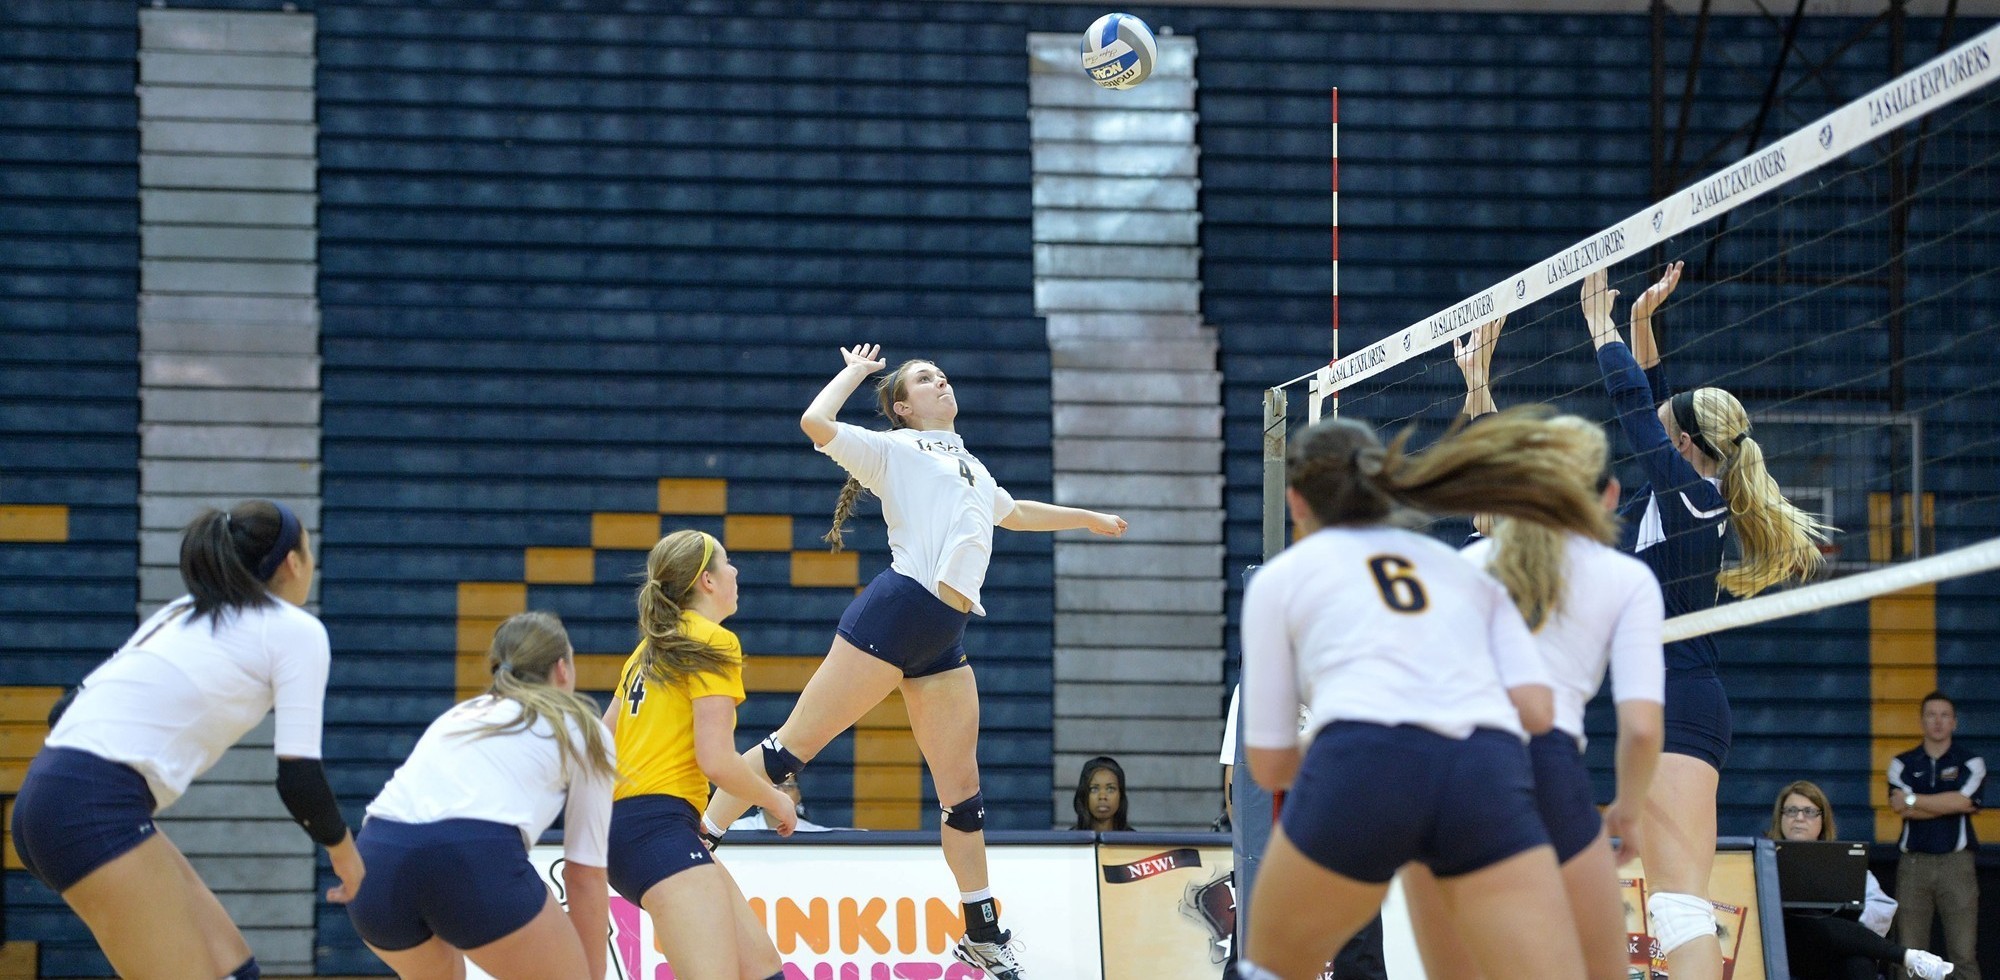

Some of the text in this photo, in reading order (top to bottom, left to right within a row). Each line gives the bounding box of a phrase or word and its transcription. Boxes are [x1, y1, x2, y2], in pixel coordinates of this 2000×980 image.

[1092, 61, 1123, 79] NCAA
[1868, 41, 1991, 127] LA SALLE EXPLORERS
[1691, 147, 1787, 215] LA SALLE EXPLORERS
[1547, 262, 1558, 284] LA
[958, 458, 975, 487] 4
[1366, 552, 1430, 615] 6
[1127, 855, 1176, 879] NEW!
